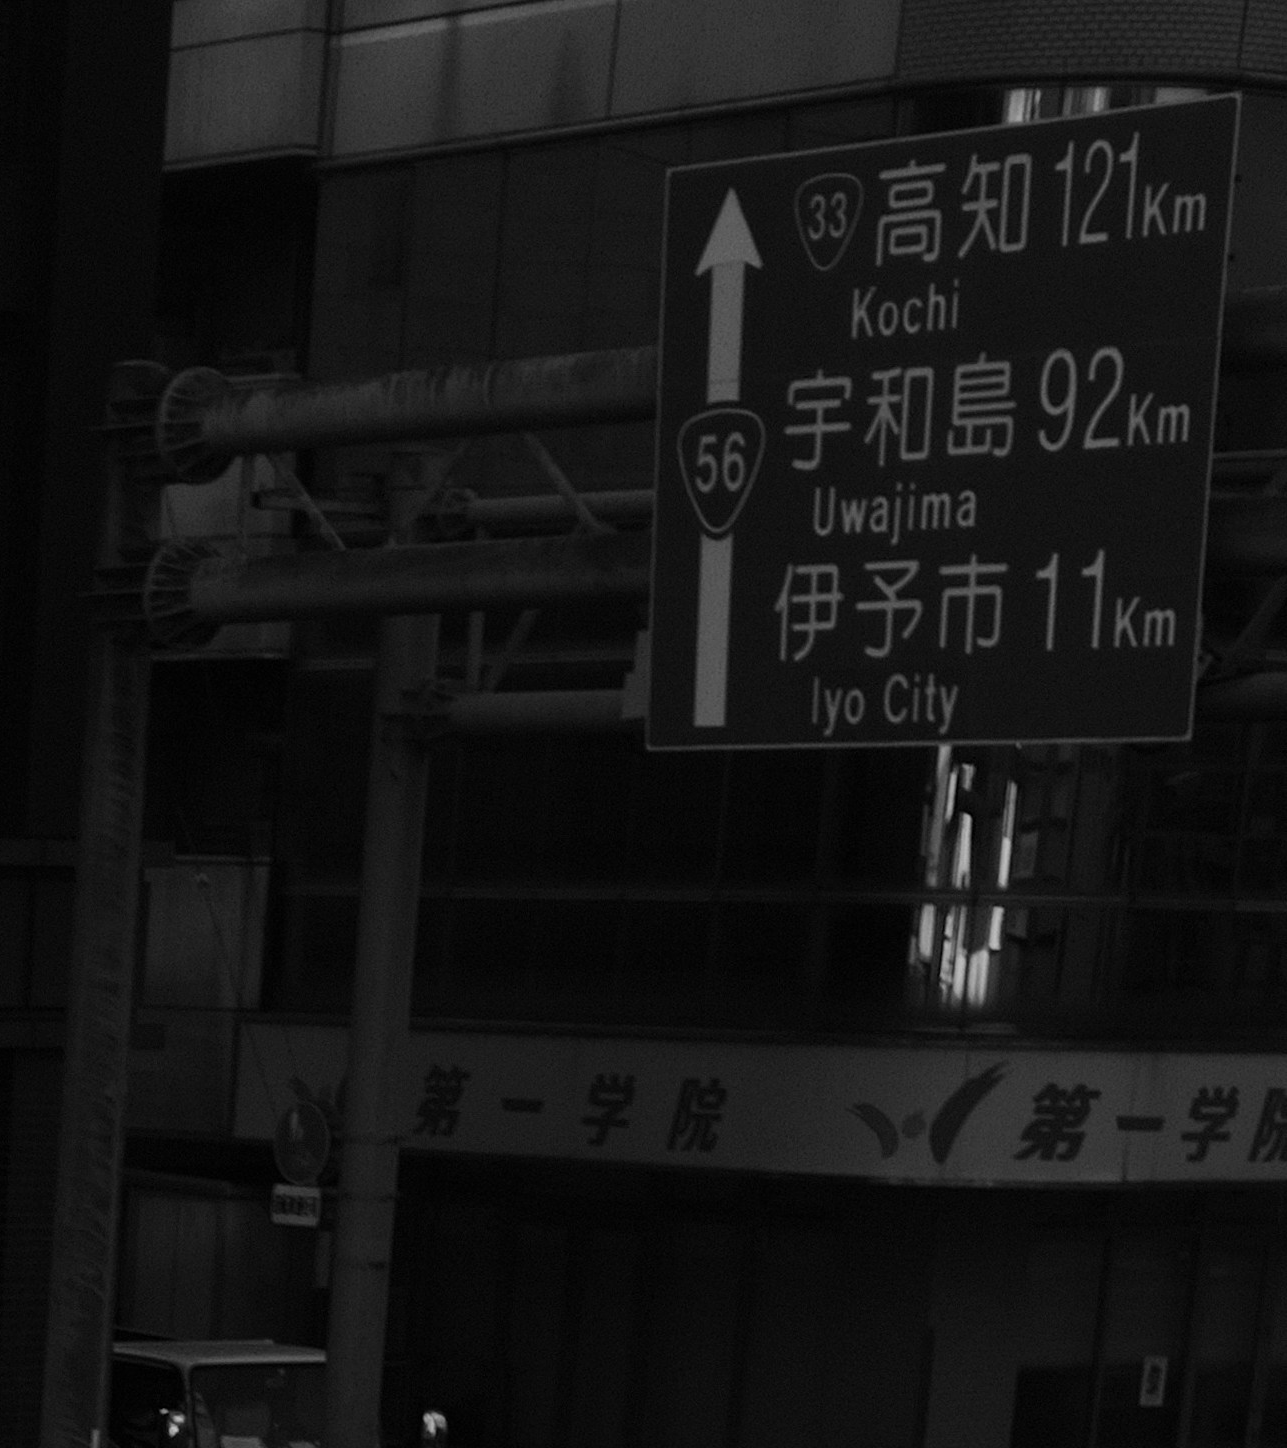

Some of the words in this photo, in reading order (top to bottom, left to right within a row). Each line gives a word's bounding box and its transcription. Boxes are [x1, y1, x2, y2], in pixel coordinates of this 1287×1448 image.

[808, 191, 848, 241] 33
[875, 153, 1033, 268] 高知
[851, 278, 961, 341] Kochi
[694, 432, 747, 494] 56
[784, 351, 1017, 471] 宇和島
[813, 481, 978, 547] Uwajima
[774, 553, 1009, 662] 伊予市
[811, 675, 865, 738] Iyo
[883, 672, 959, 736] City
[413, 1064, 727, 1152] 第一学院
